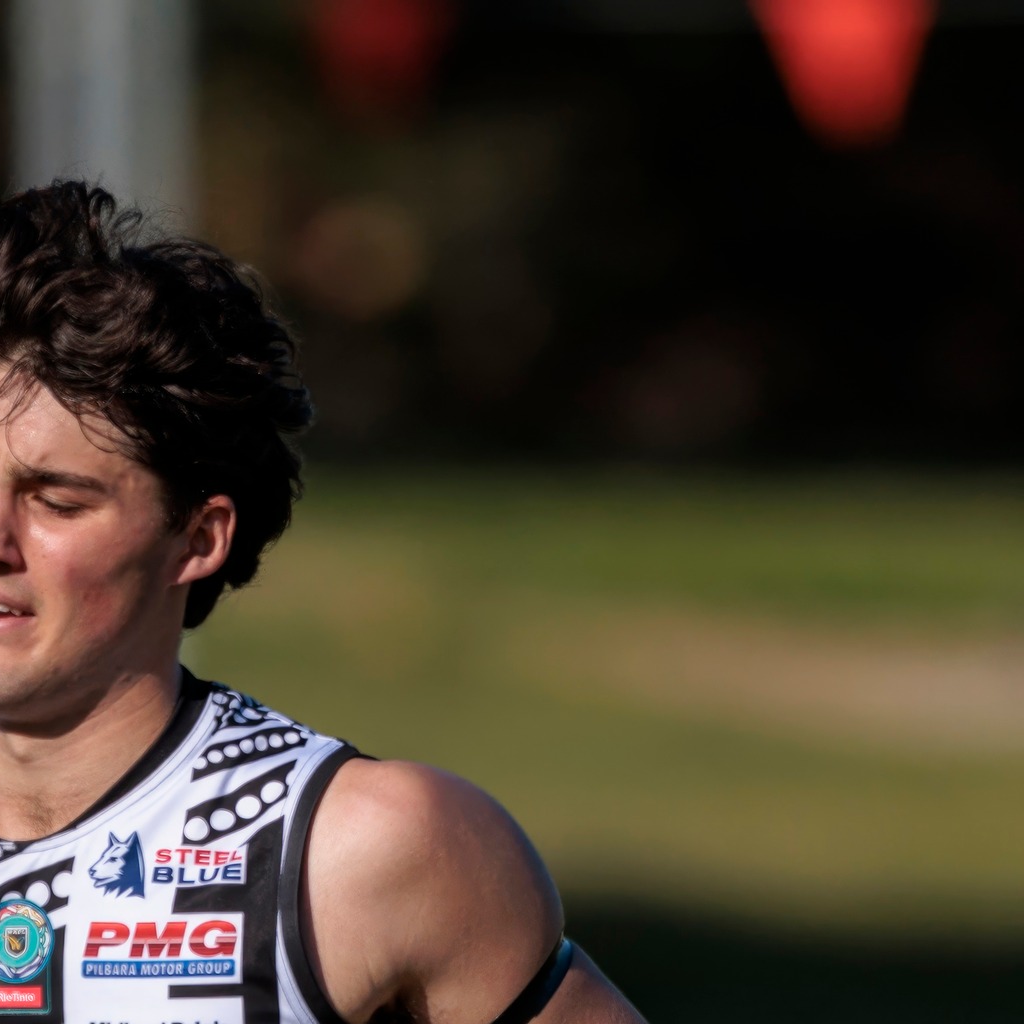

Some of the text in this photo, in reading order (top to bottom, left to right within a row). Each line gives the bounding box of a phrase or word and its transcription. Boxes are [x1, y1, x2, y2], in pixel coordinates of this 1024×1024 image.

[155, 848, 242, 866] STEEL
[152, 863, 242, 885] BLUE
[82, 919, 238, 959] PMG
[85, 961, 232, 976] PILBARA MOTOR GROUP
